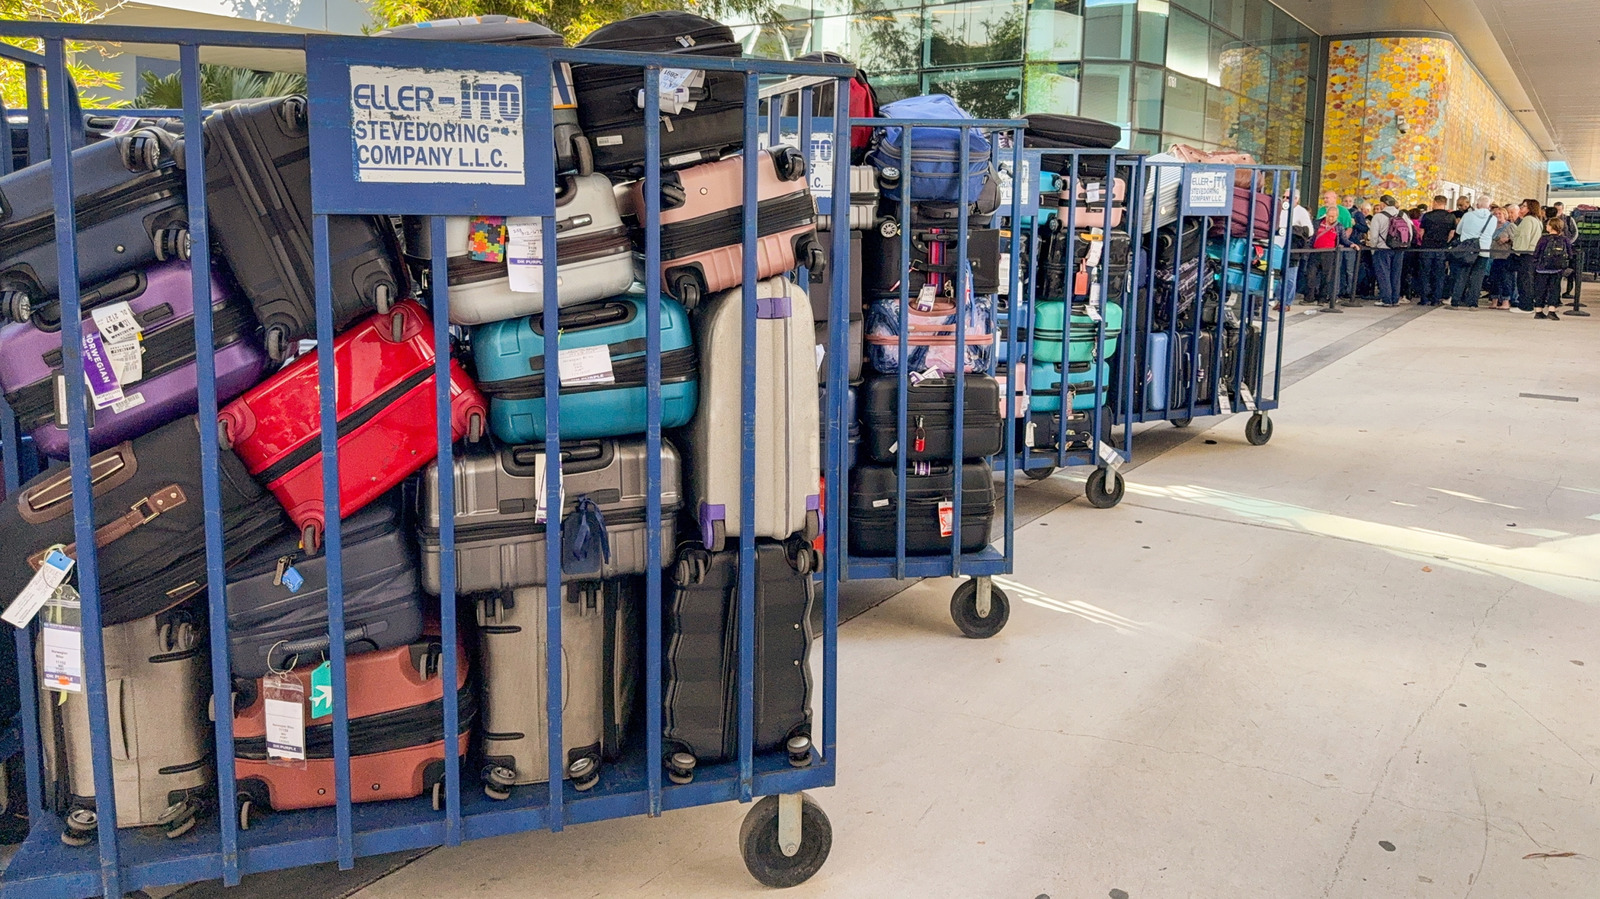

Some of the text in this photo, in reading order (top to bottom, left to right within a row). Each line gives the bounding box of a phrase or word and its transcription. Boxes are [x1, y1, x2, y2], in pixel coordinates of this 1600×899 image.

[354, 120, 490, 144] STEVEDORING
[358, 144, 508, 168] COMPANY L.L.C.
[86, 333, 111, 383] NORWEGIAN
